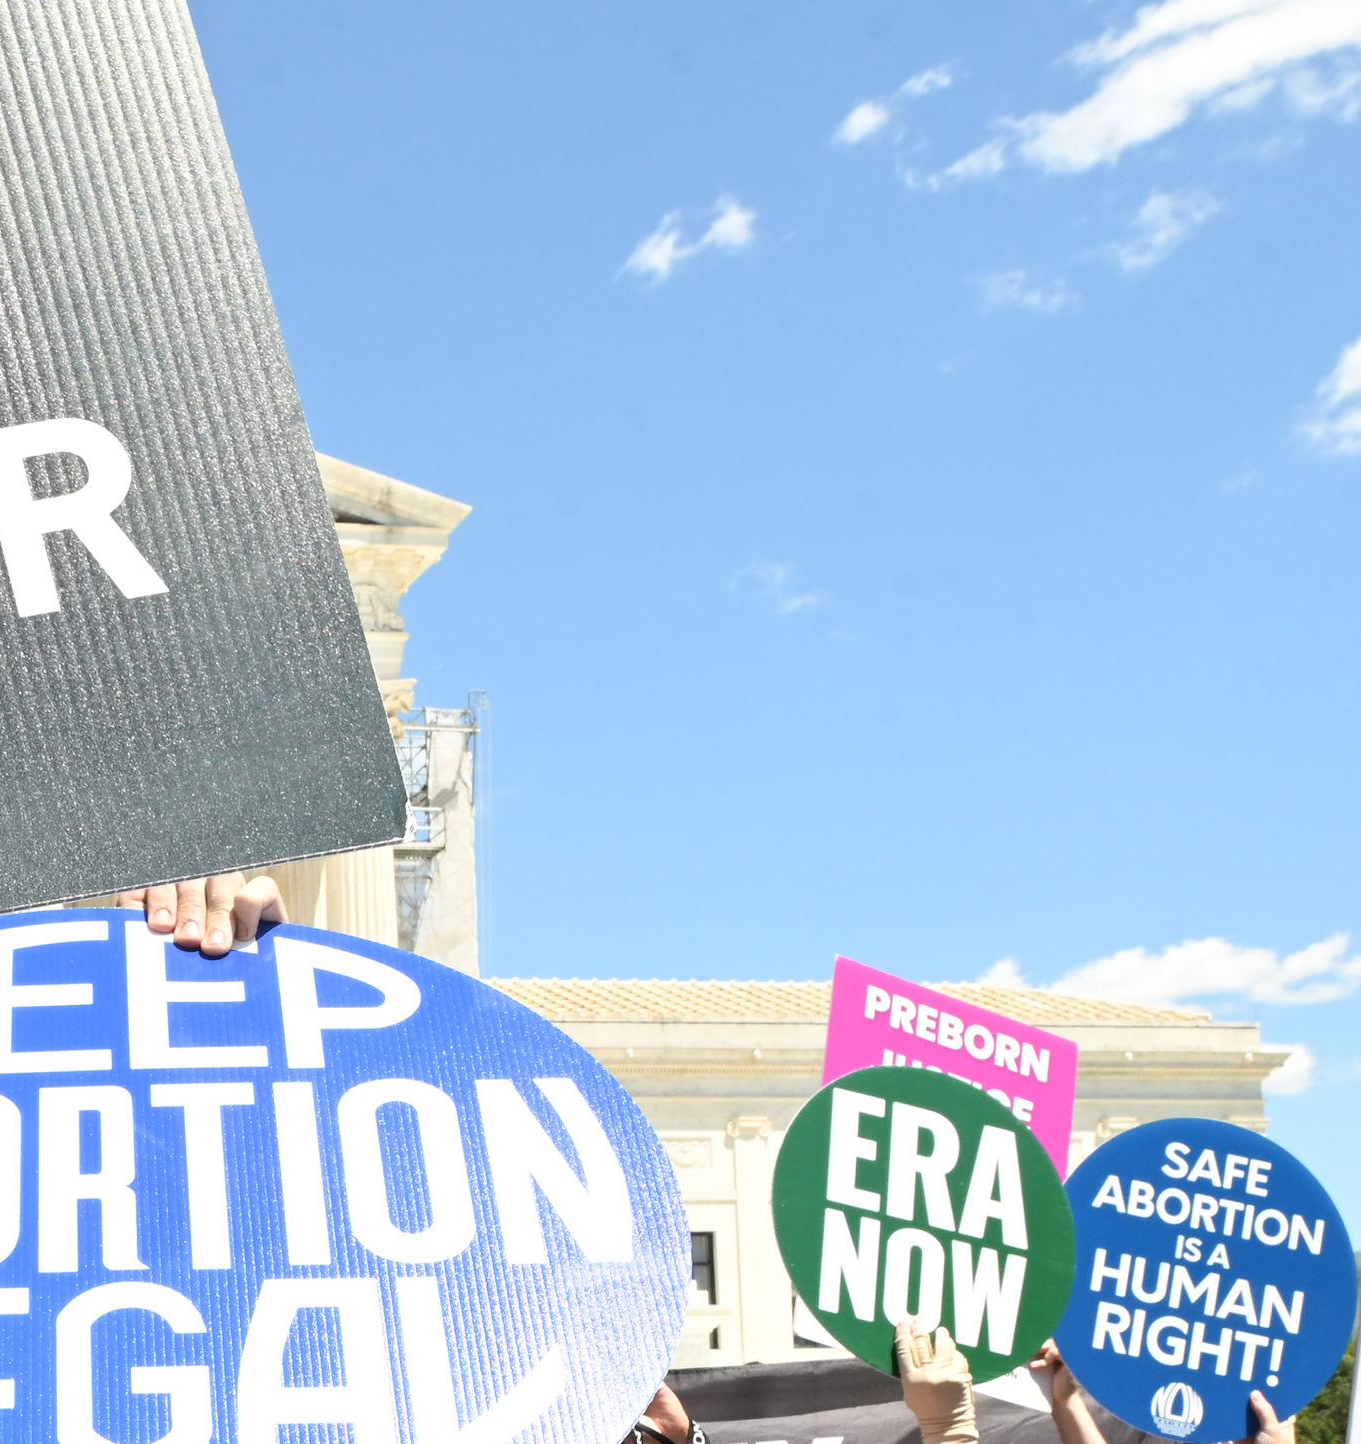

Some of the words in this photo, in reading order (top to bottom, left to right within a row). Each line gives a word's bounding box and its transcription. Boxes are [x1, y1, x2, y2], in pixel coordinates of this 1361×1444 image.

[864, 984, 1050, 1083] PREBORN
[826, 1087, 1029, 1251] ERA
[1161, 1142, 1272, 1198] SAFE
[1091, 1174, 1325, 1256] ABORTION
[1175, 1235, 1203, 1262] IS
[1207, 1243, 1231, 1269] A
[818, 1207, 1028, 1357] NOW
[1090, 1248, 1305, 1335] HUMAN
[1091, 1301, 1285, 1389] RIGHT!
